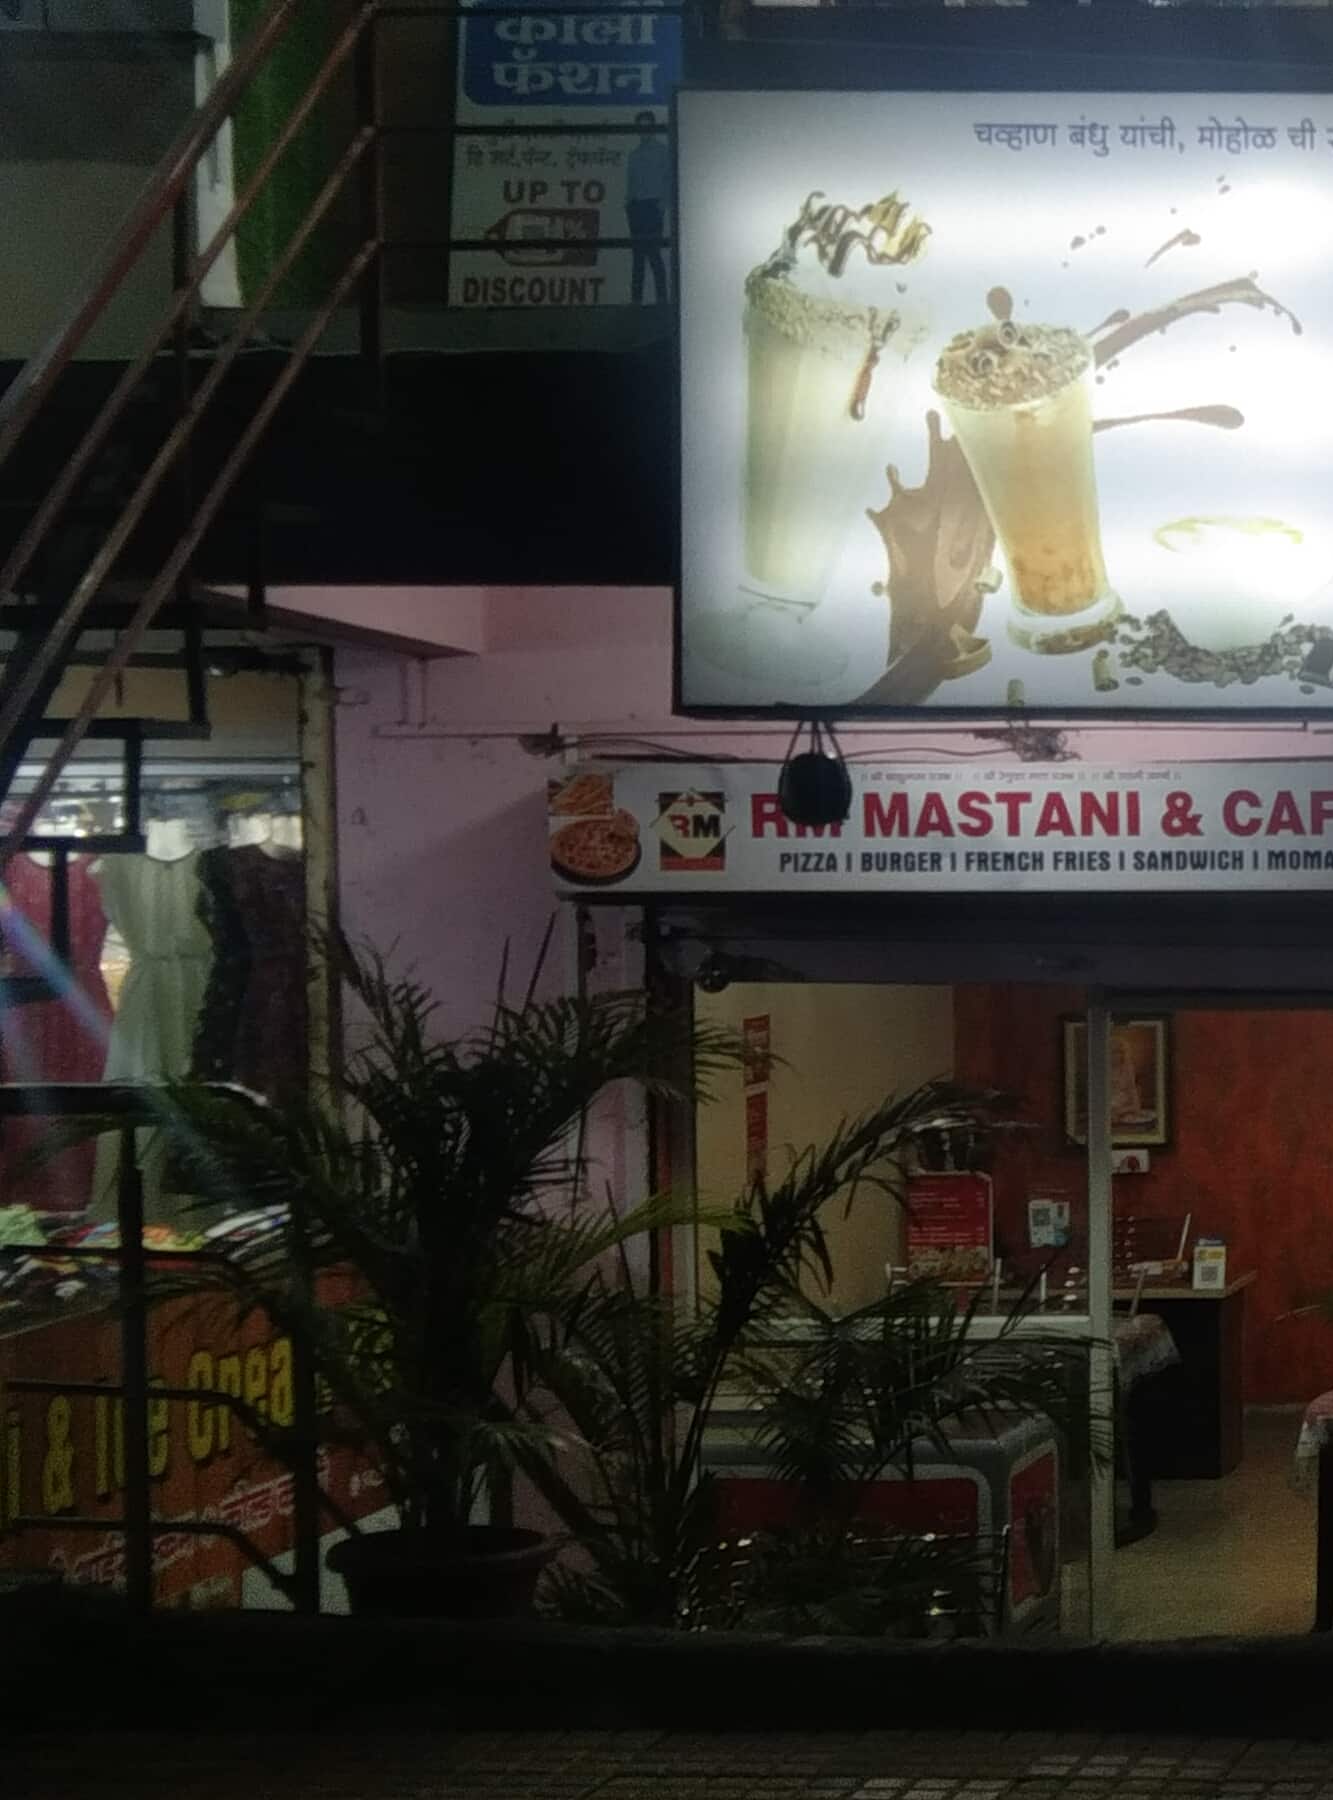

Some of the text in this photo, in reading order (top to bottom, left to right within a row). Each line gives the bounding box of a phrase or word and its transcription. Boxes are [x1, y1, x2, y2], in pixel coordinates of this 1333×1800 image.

[973, 121, 1058, 150] चव्हाण
[1067, 114, 1110, 157] बंधु
[1119, 115, 1184, 153] यांची,
[1197, 116, 1278, 153] मोहोळ
[1288, 116, 1317, 150] ची
[503, 180, 606, 204] UP TO
[462, 277, 605, 304] DISCOUNT
[669, 814, 719, 838] RM
[863, 791, 1140, 838] MASTANI
[1160, 790, 1204, 837] &
[779, 851, 838, 872] PIZZA
[860, 851, 943, 872] BURGER
[964, 851, 1045, 872] FRENCH
[1052, 851, 1111, 872] FRIES
[1132, 851, 1245, 872] SANDWICH
[188, 1335, 334, 1462] Crea
